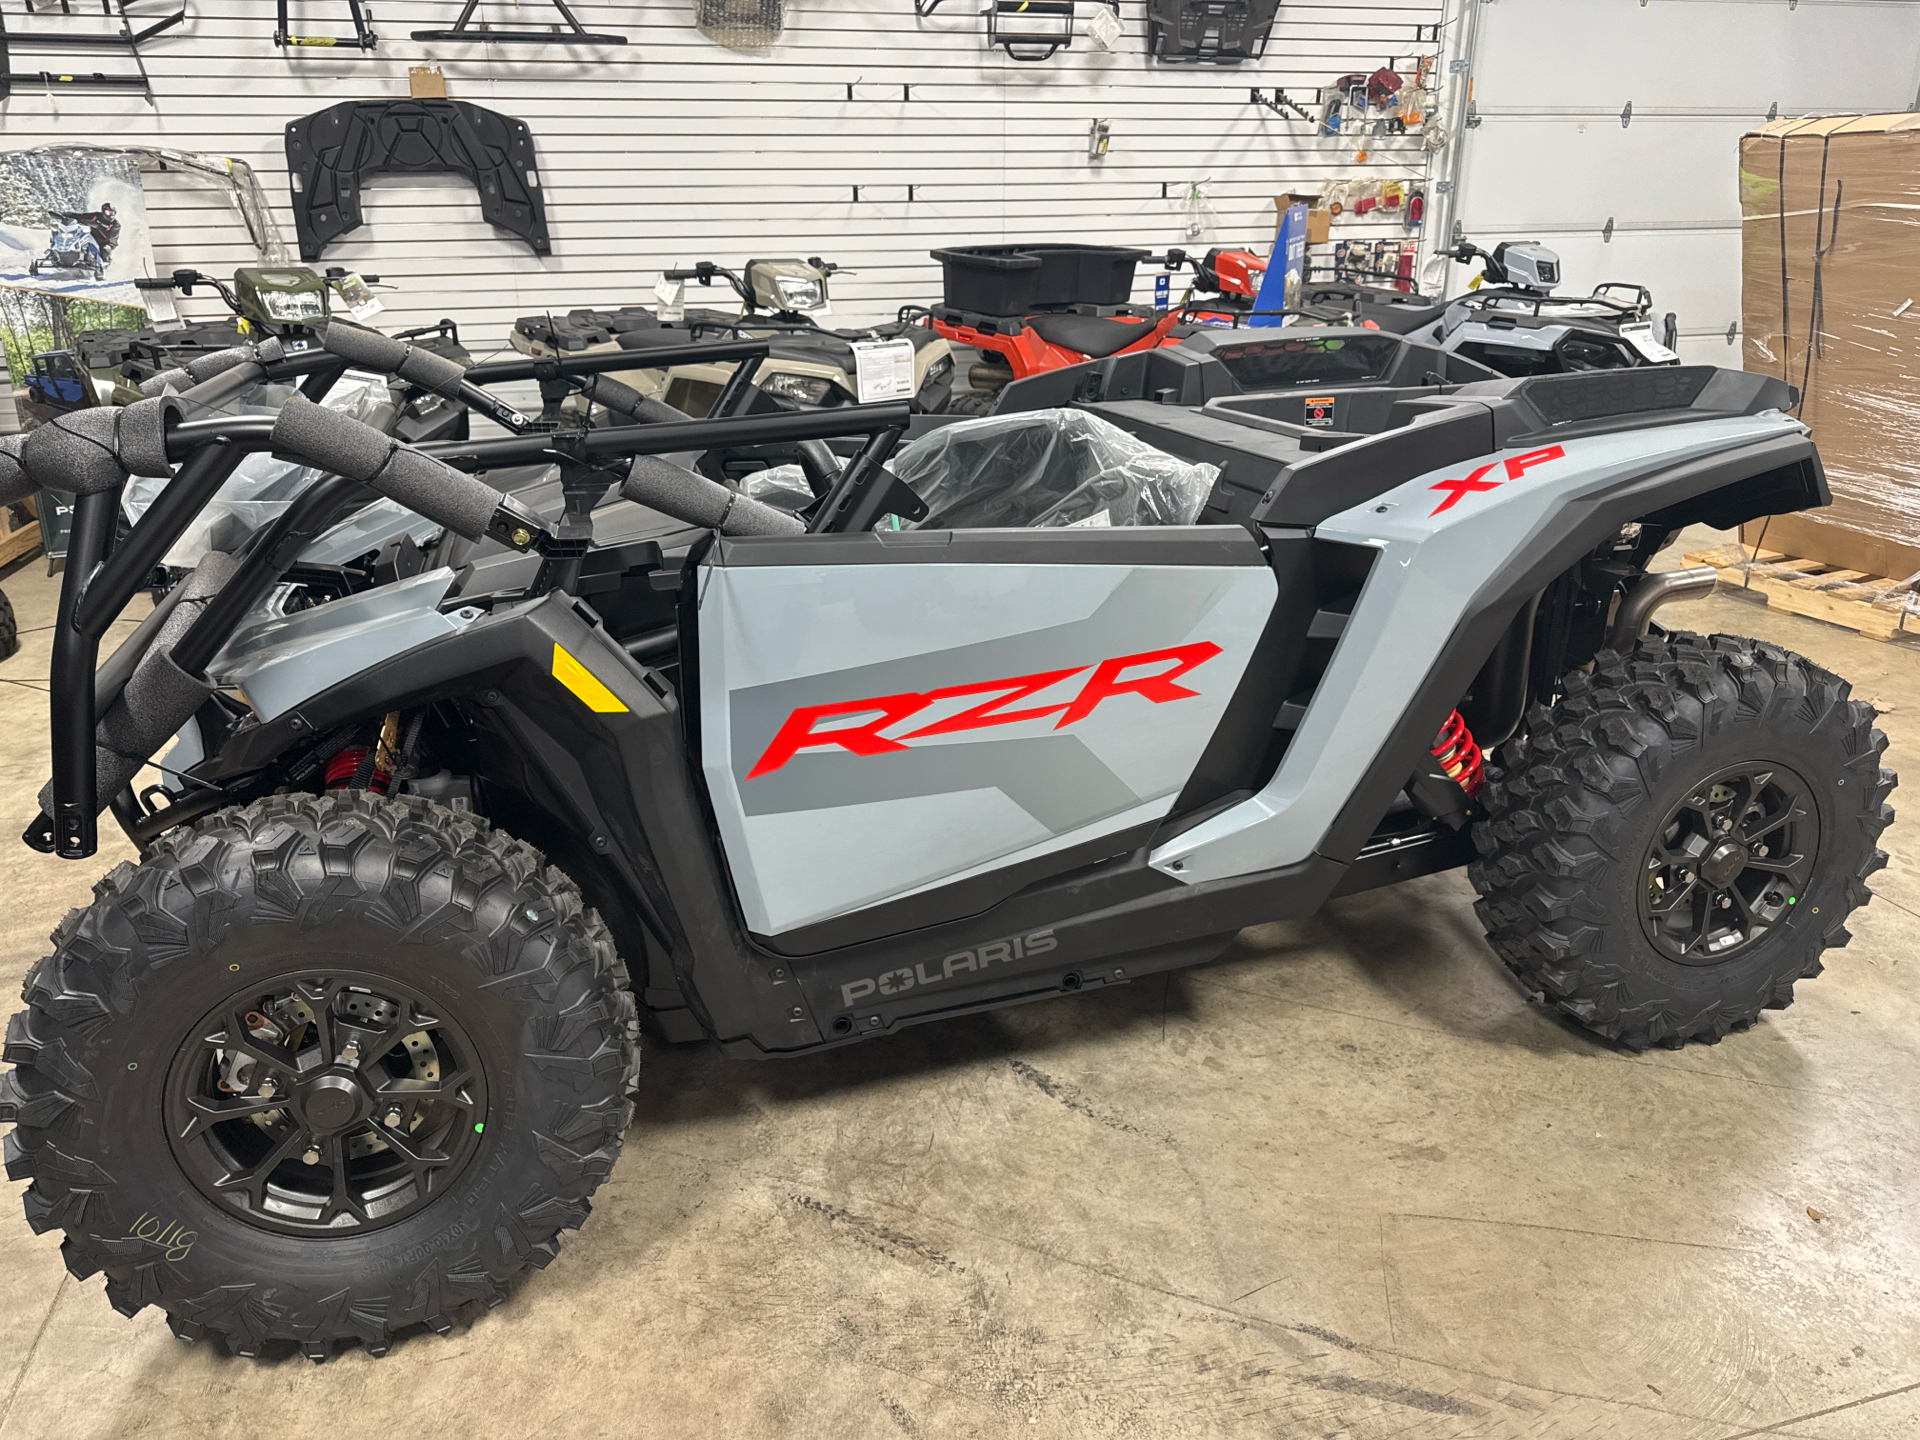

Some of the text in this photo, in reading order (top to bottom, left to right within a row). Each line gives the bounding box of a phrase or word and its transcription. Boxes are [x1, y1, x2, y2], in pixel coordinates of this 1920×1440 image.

[1428, 443, 1565, 516] XP
[743, 639, 1223, 781] RZR
[840, 927, 1059, 1008] POLARIS
